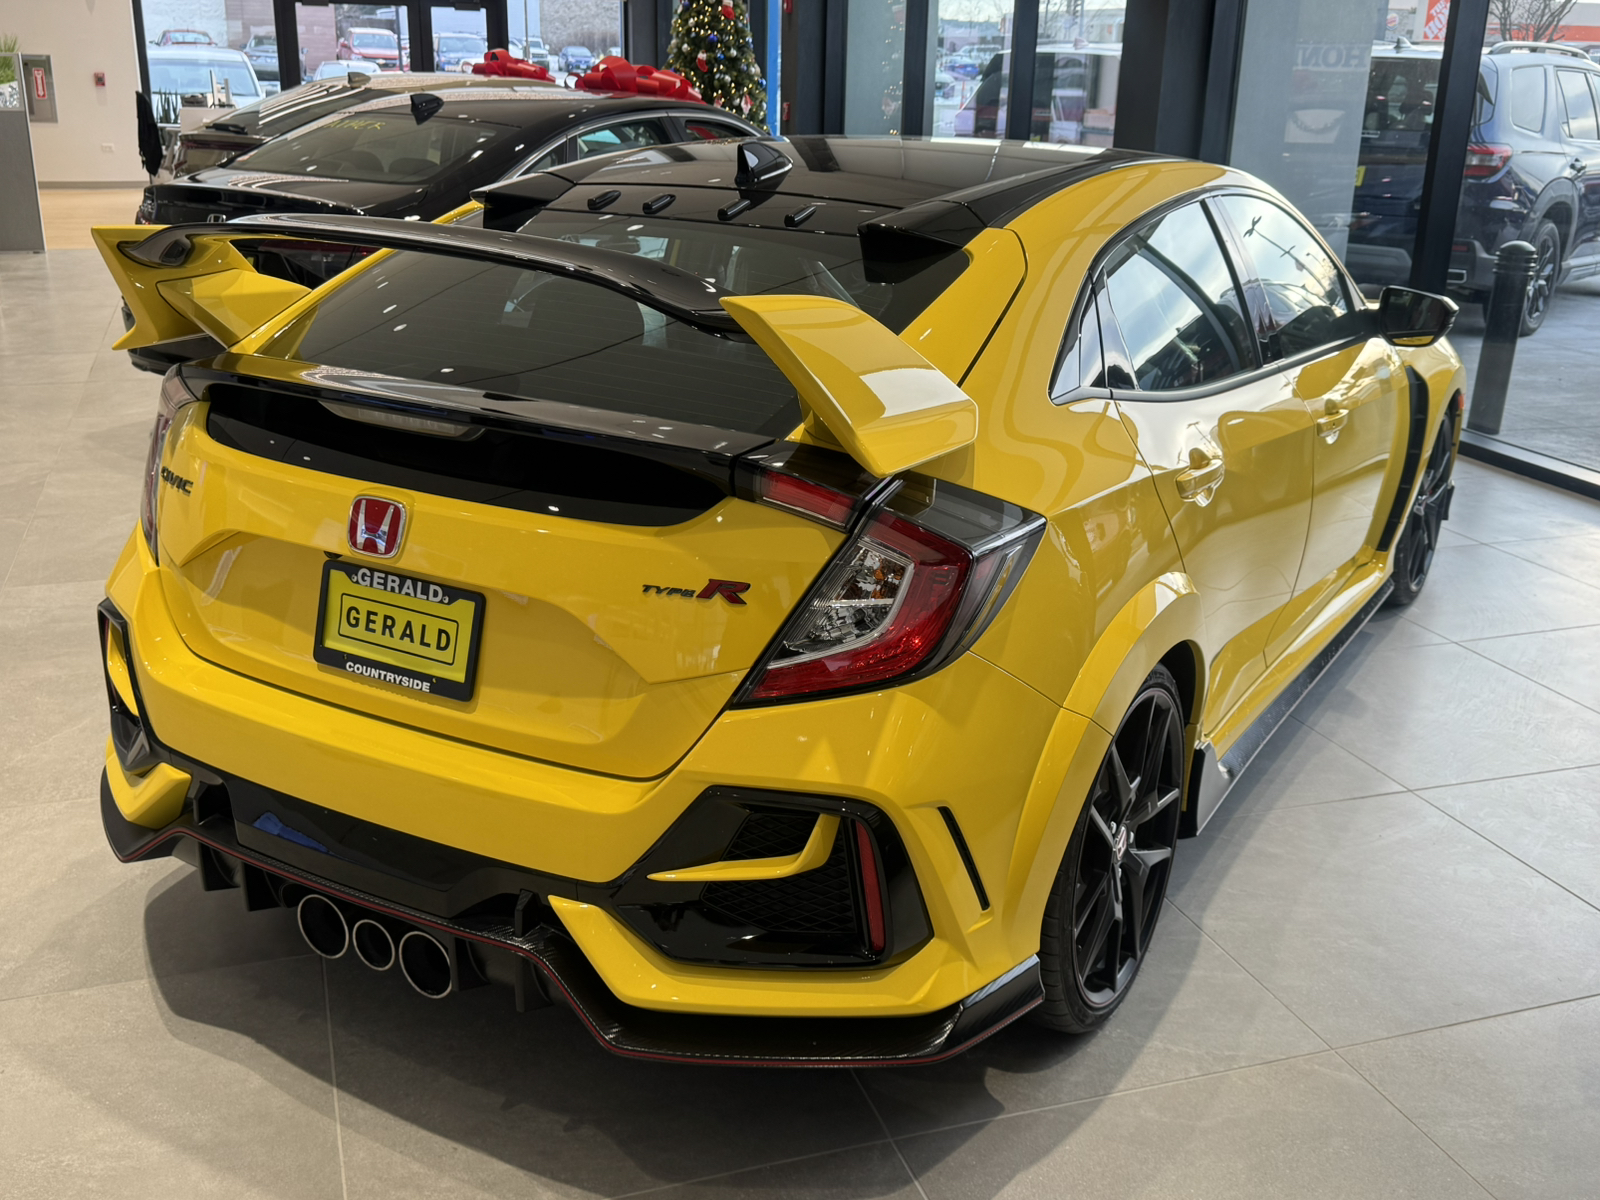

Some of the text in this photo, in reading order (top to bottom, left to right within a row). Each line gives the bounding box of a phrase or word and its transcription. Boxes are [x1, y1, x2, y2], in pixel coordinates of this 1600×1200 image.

[357, 568, 443, 603] GERALD
[642, 578, 751, 605] TYPE R
[346, 605, 451, 651] GERALD
[345, 661, 431, 693] COUNTRYSIDE
